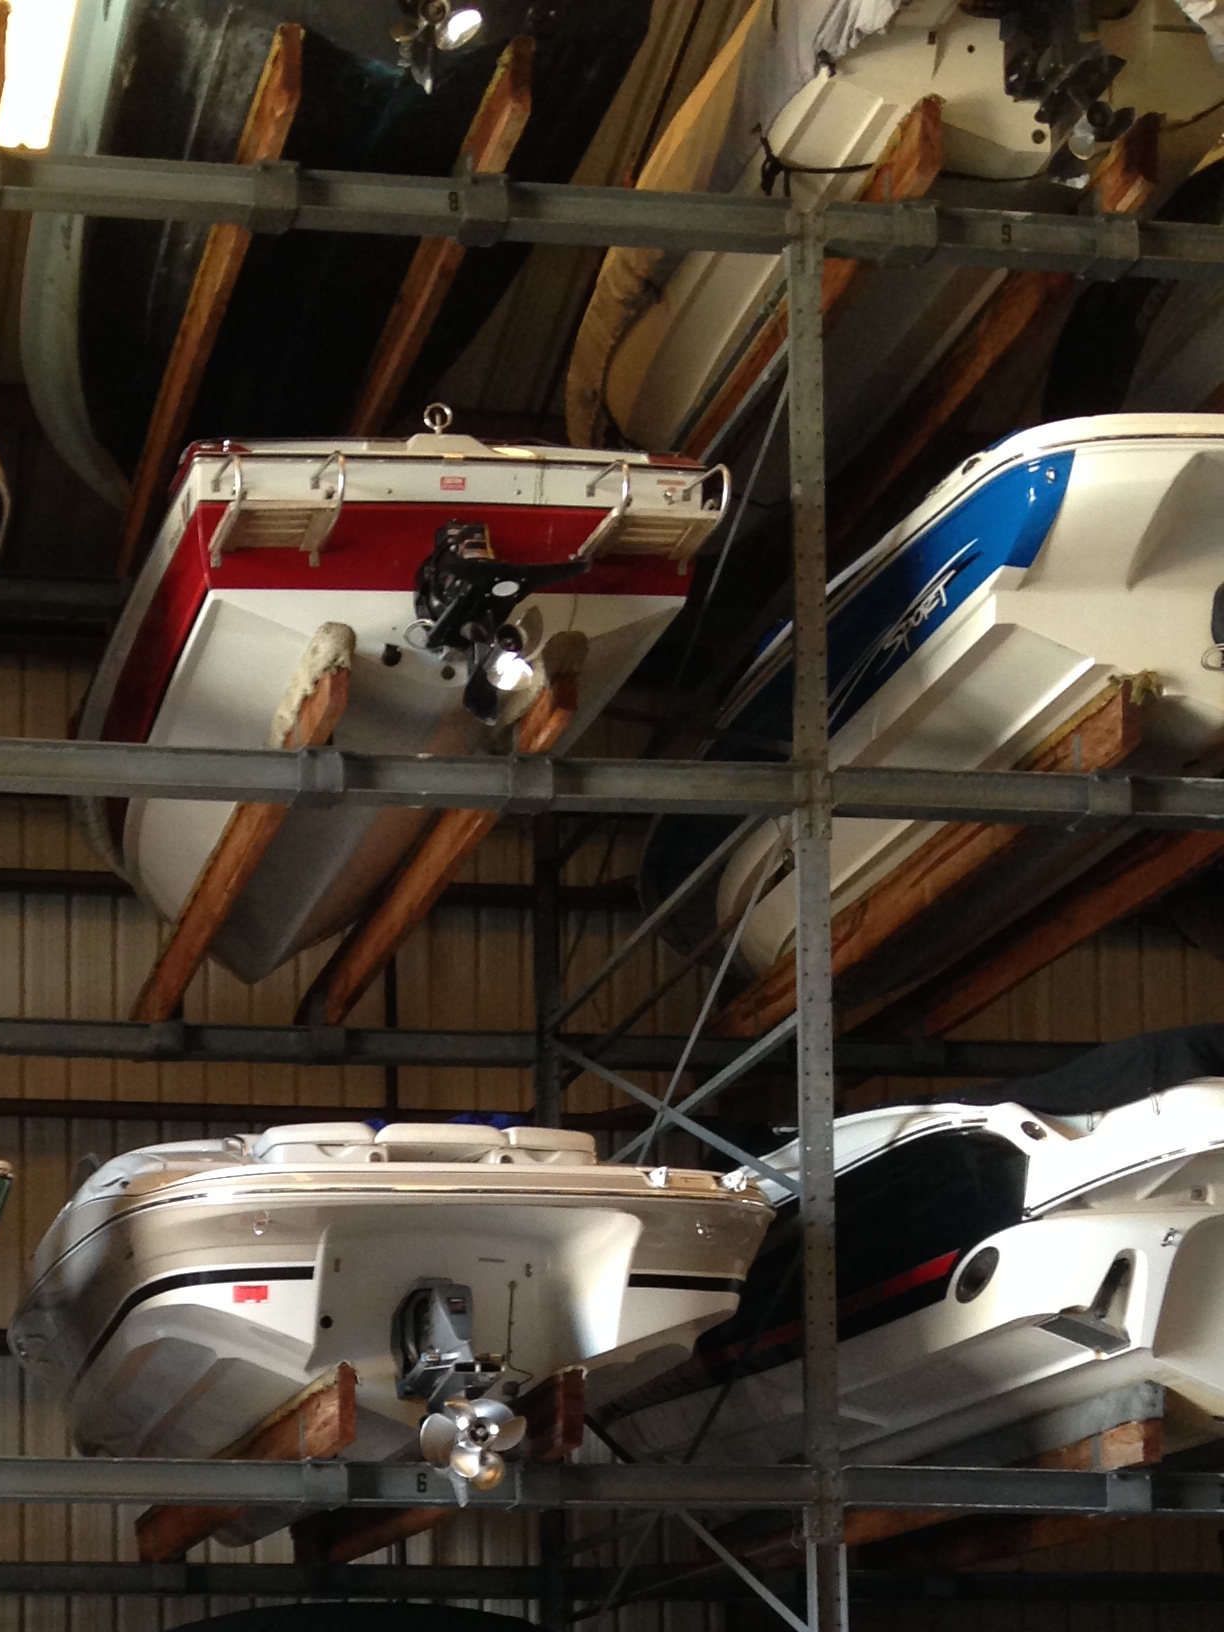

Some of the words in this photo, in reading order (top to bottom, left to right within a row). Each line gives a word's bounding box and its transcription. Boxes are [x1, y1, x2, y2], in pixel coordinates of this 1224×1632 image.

[447, 190, 459, 212] 8
[1000, 222, 1013, 244] 9
[416, 1472, 428, 1493] 6
